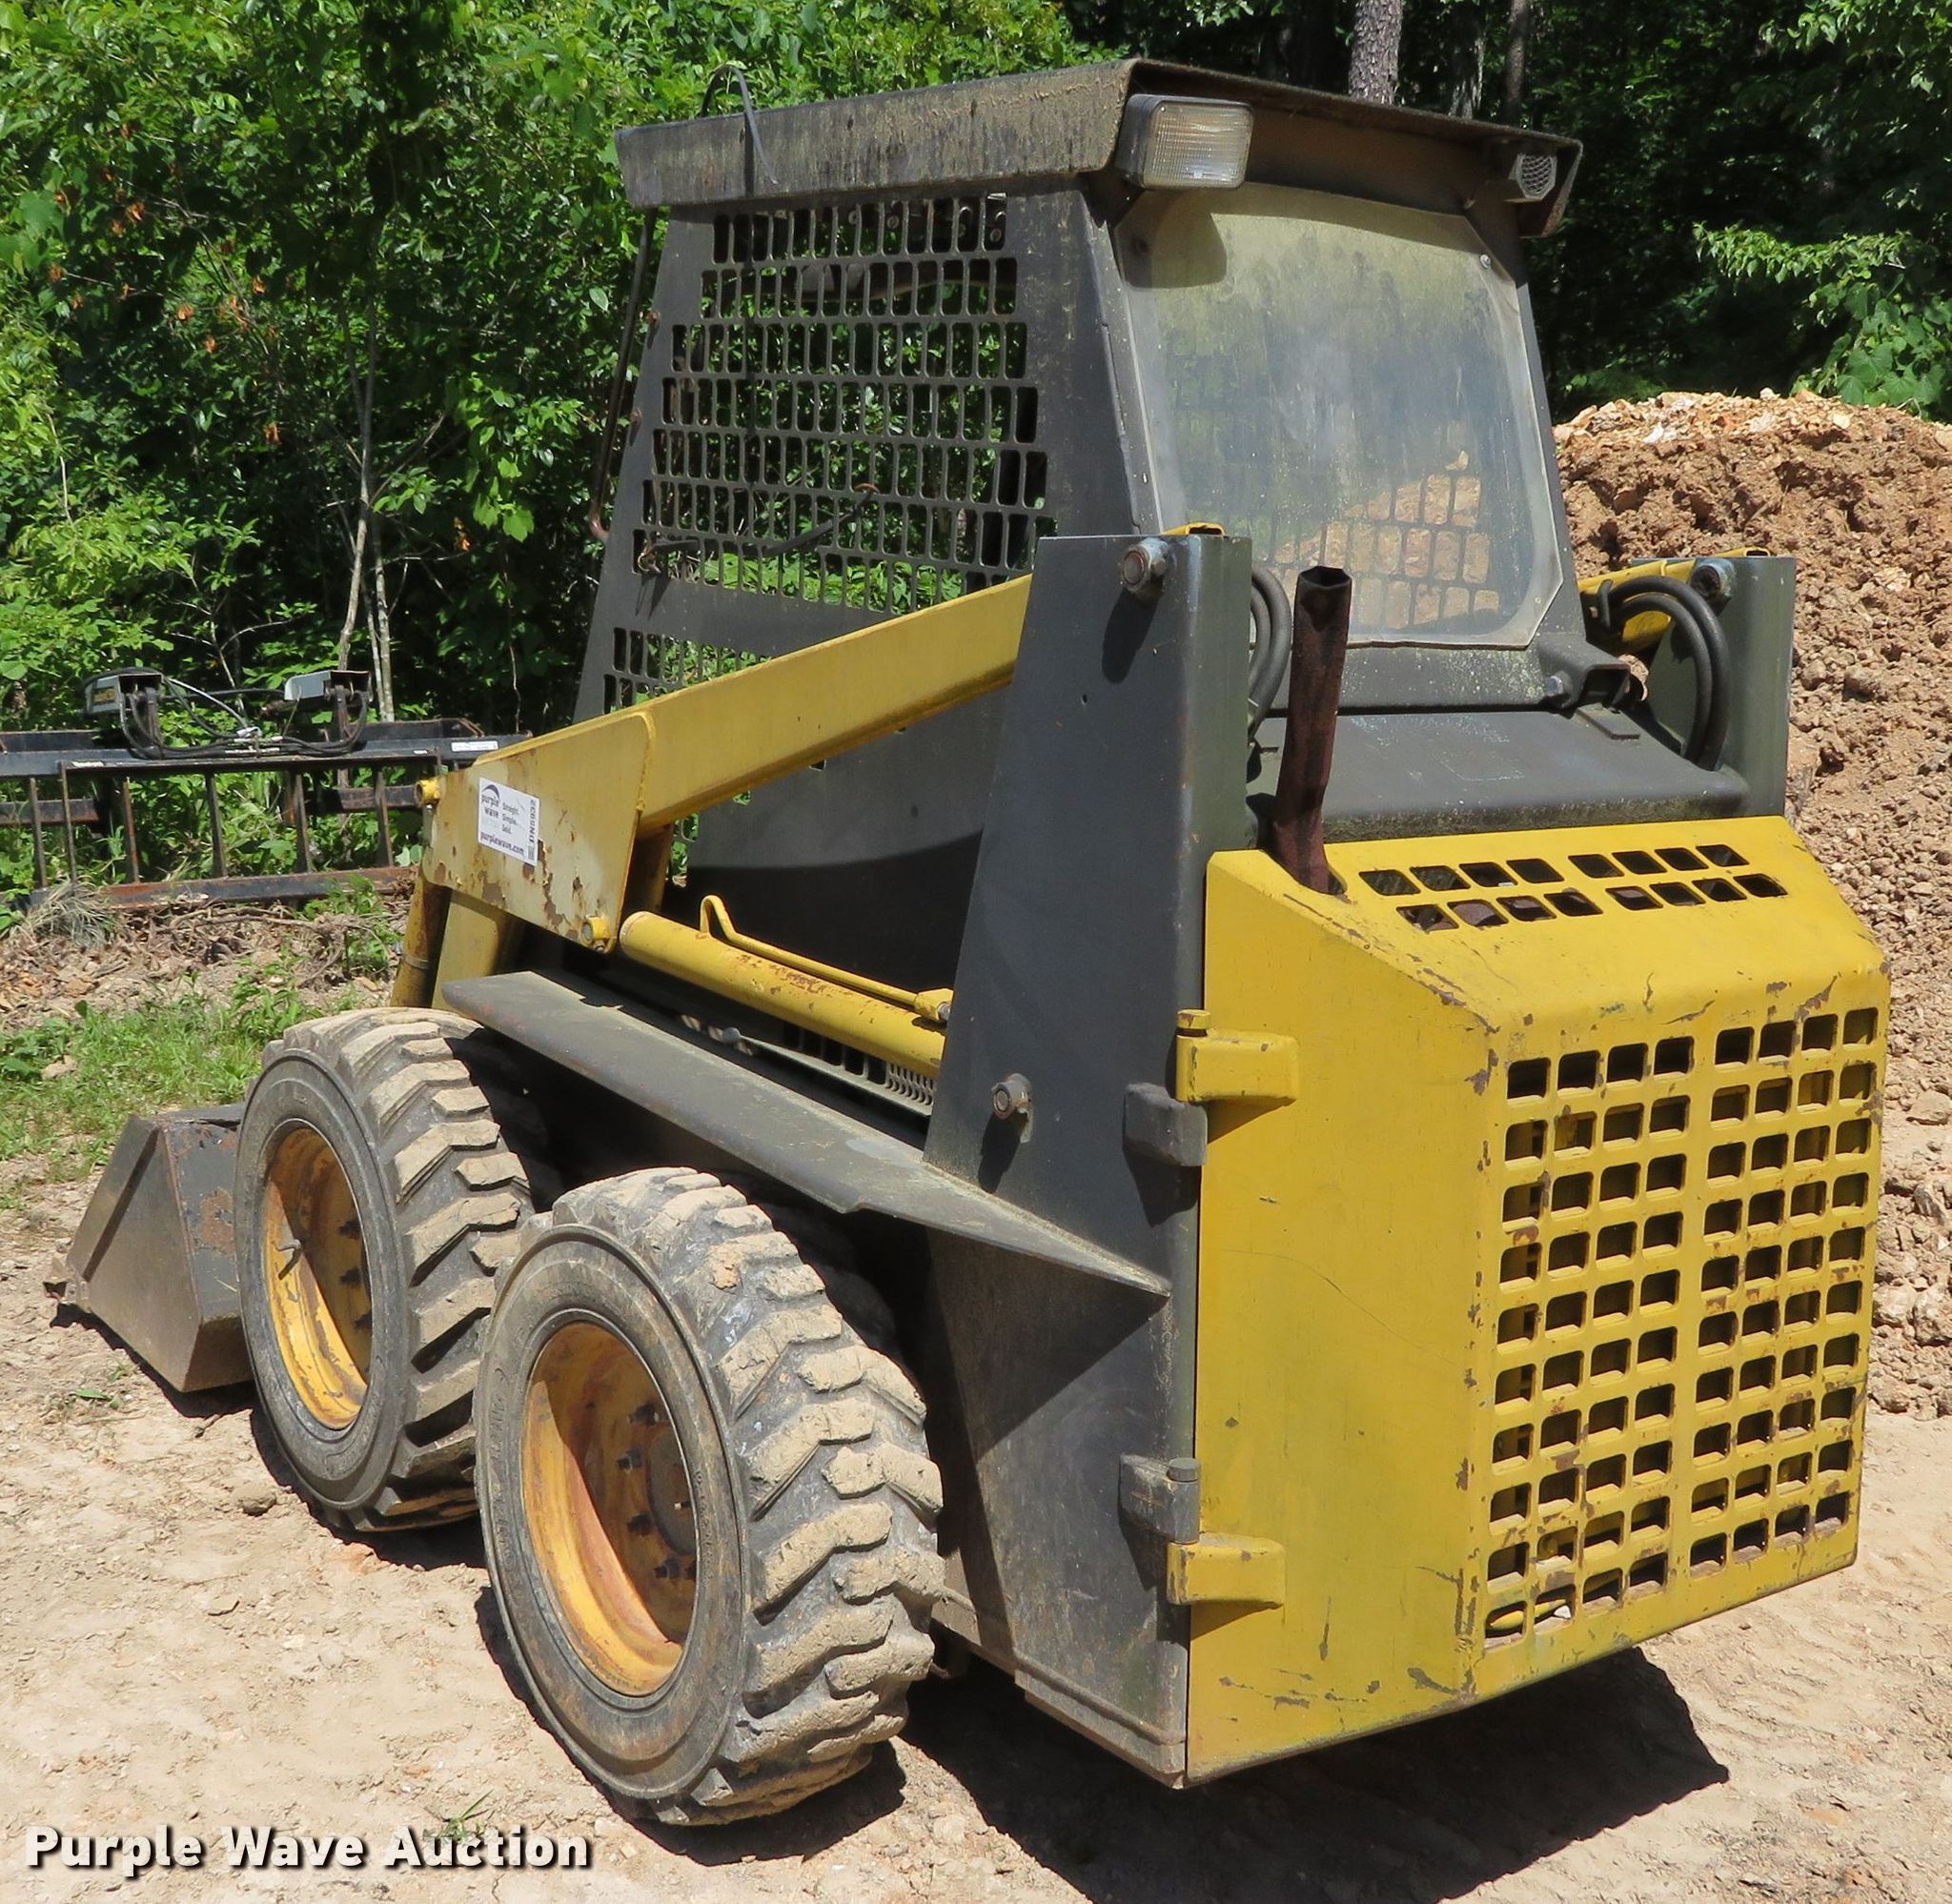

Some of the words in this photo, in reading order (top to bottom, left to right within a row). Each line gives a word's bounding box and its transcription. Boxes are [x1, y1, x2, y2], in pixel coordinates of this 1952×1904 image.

[481, 794, 499, 808] purple
[484, 807, 498, 819] wave
[480, 831, 524, 856] purplewave.com
